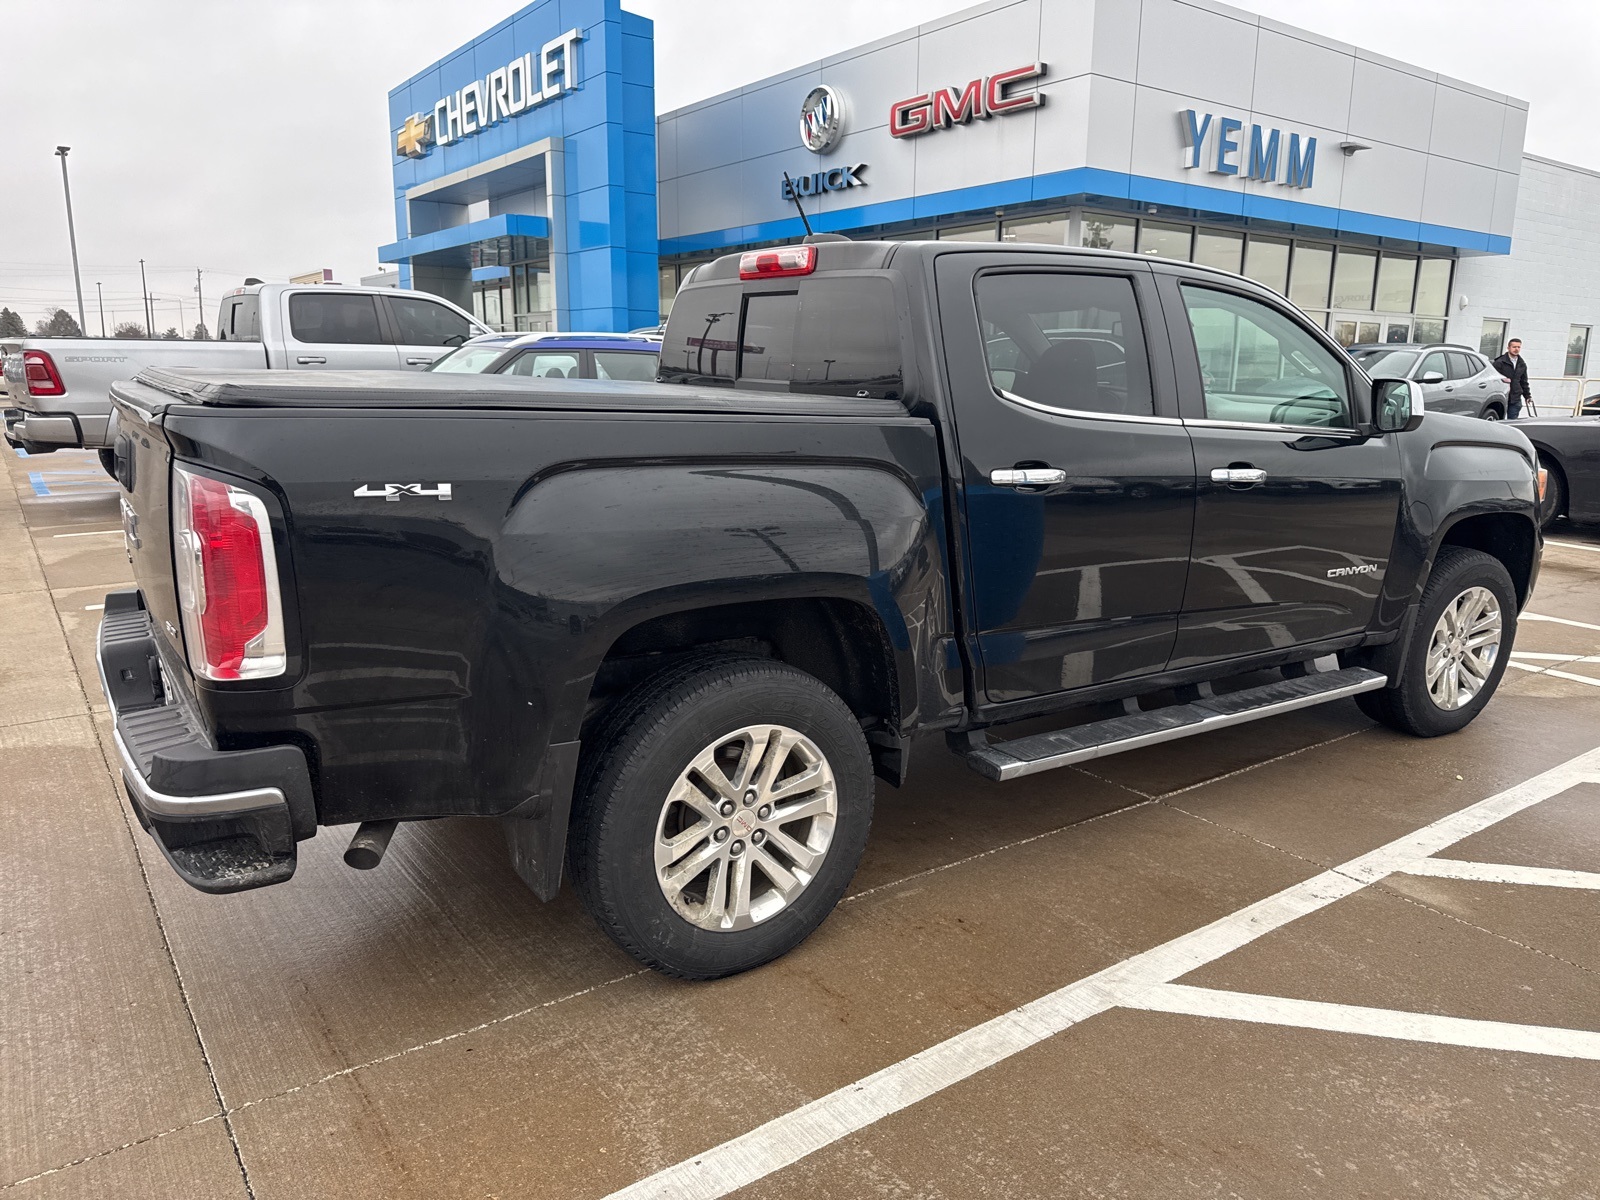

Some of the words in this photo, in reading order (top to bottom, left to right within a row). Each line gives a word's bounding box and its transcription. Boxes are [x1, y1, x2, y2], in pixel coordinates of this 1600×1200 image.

[434, 27, 581, 147] CHEVROLET
[890, 61, 1048, 140] GMC
[781, 163, 868, 201] BUICK
[1180, 109, 1317, 189] YEMM
[1326, 563, 1378, 578] CANYON
